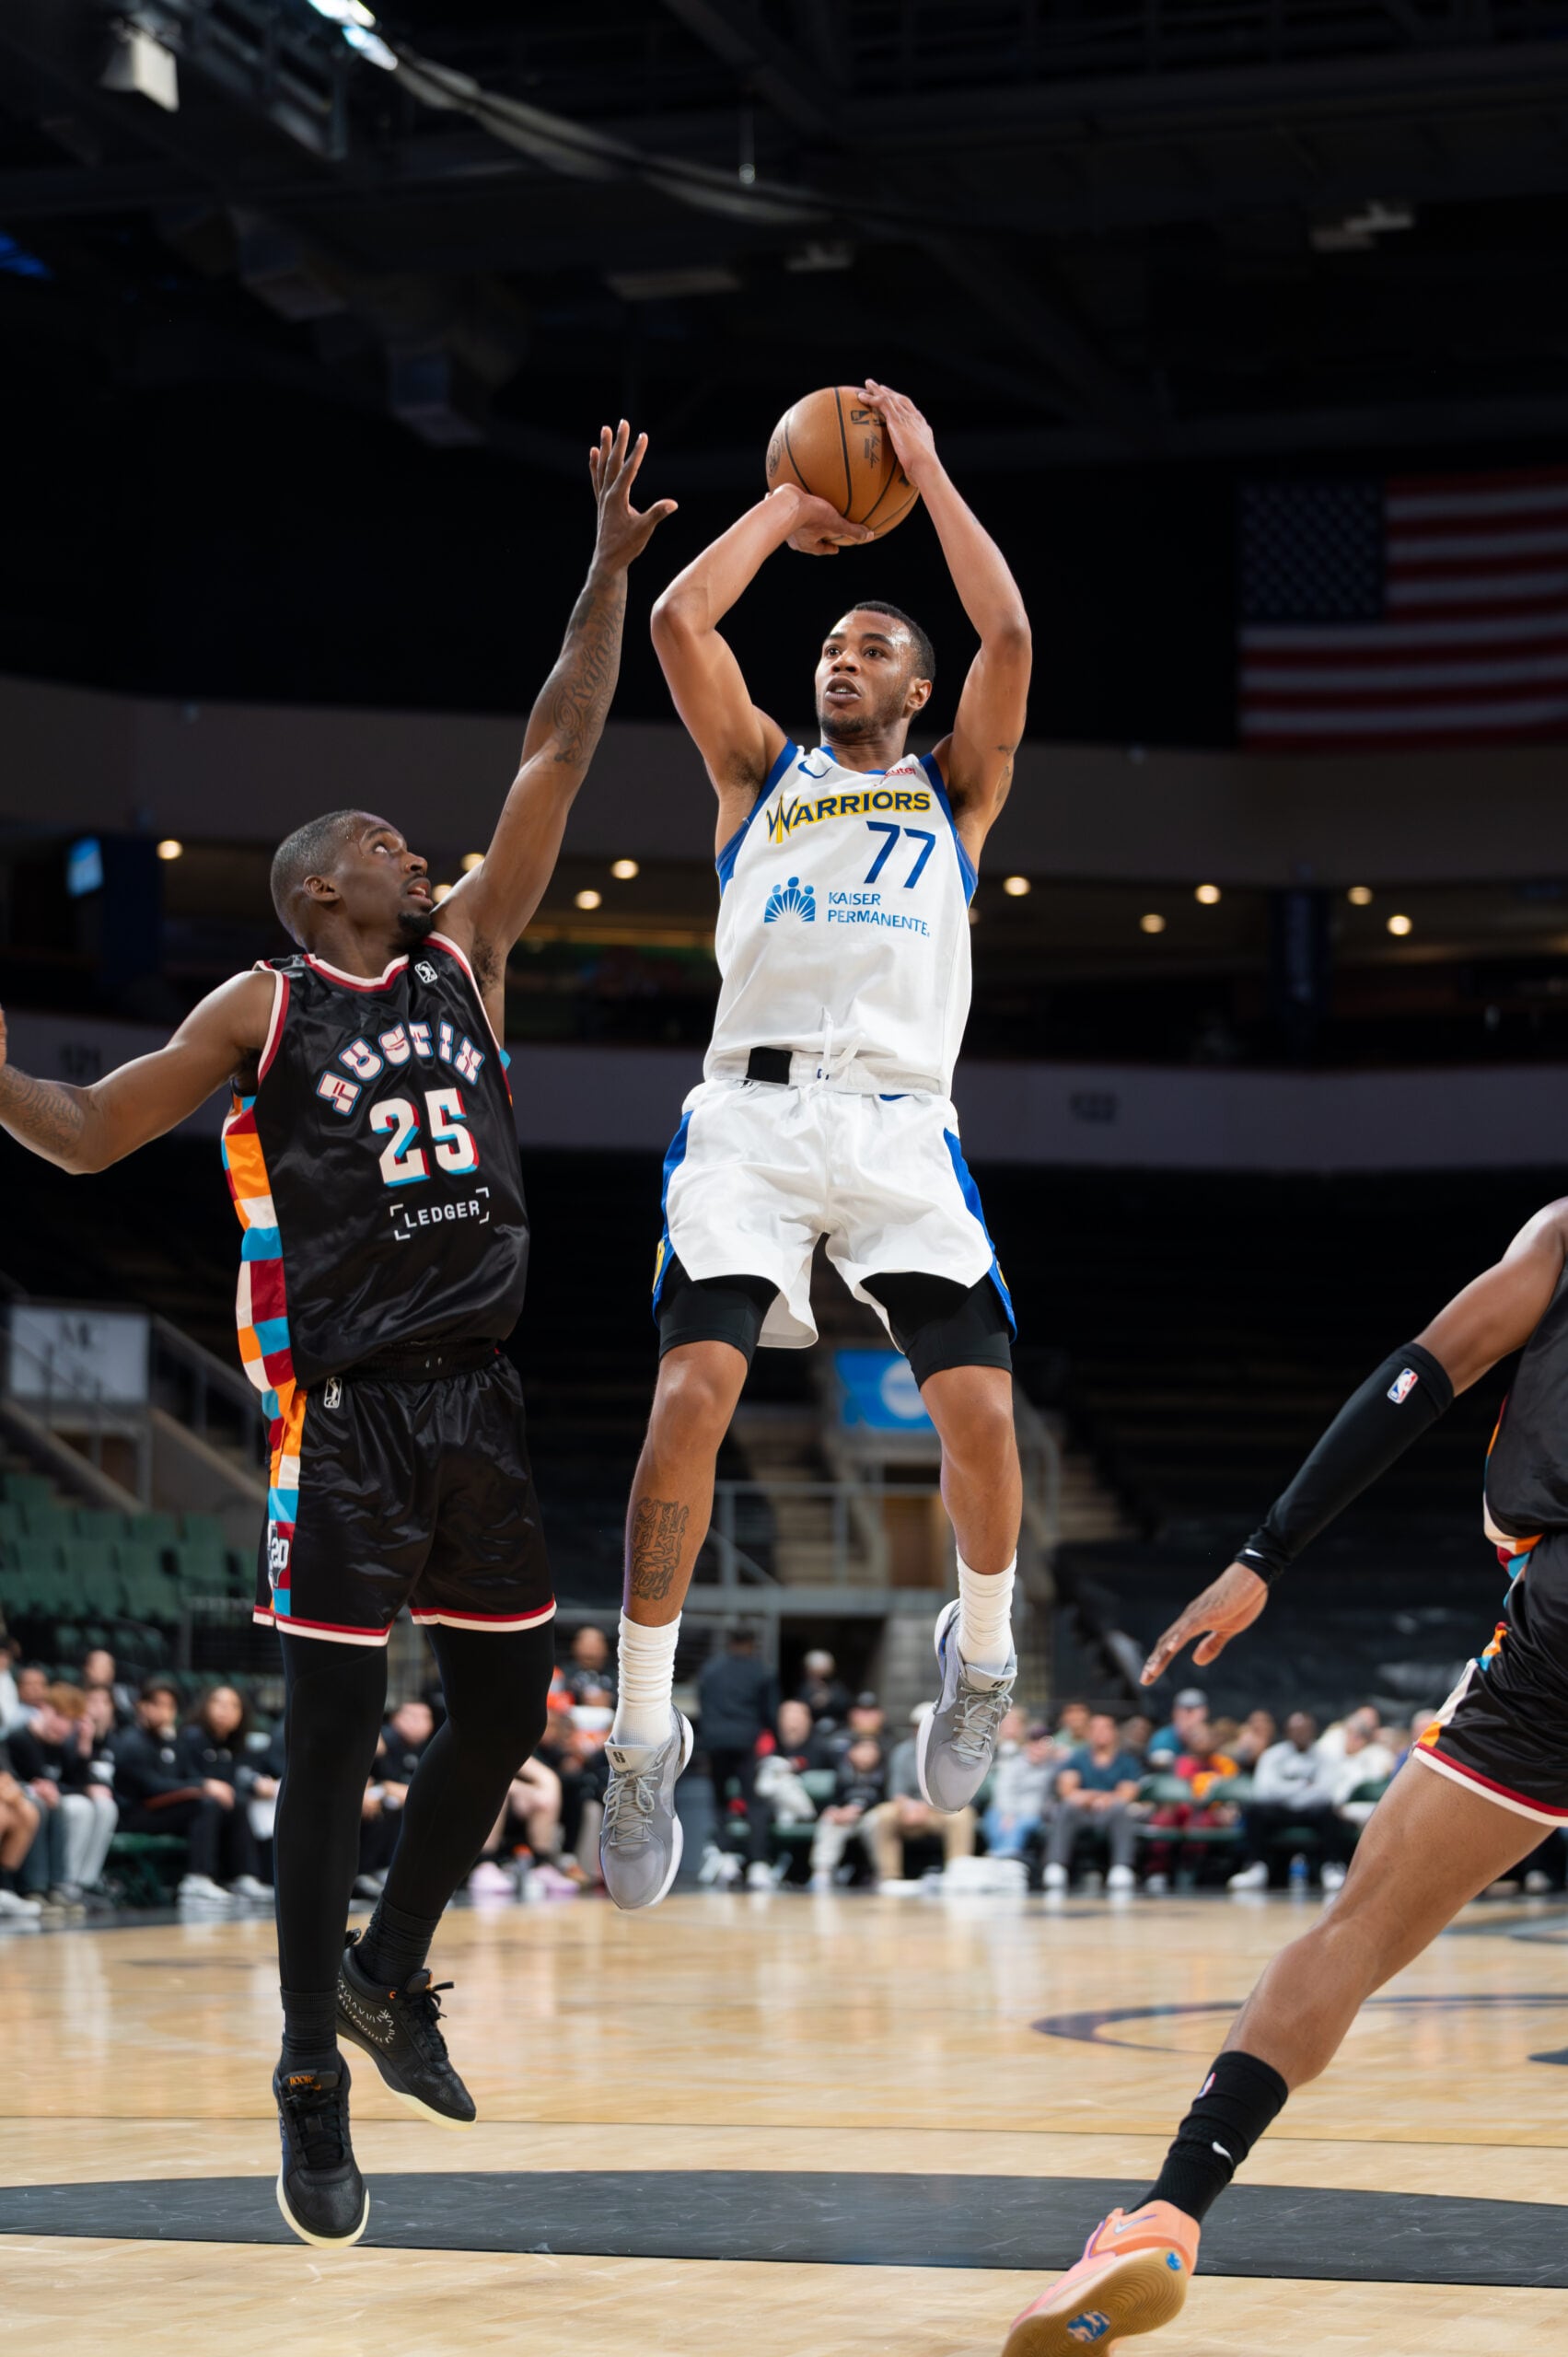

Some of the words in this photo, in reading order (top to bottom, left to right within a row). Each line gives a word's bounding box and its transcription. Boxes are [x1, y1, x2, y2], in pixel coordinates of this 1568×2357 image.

[766, 791, 931, 844] WARRIORS
[864, 820, 936, 889] 77
[828, 910, 929, 937] PERMANENTE
[829, 891, 881, 905] KAISER
[317, 1021, 485, 1116] AUSTIN
[369, 1087, 480, 1188] 25
[403, 1199, 481, 1228] LEDGER
